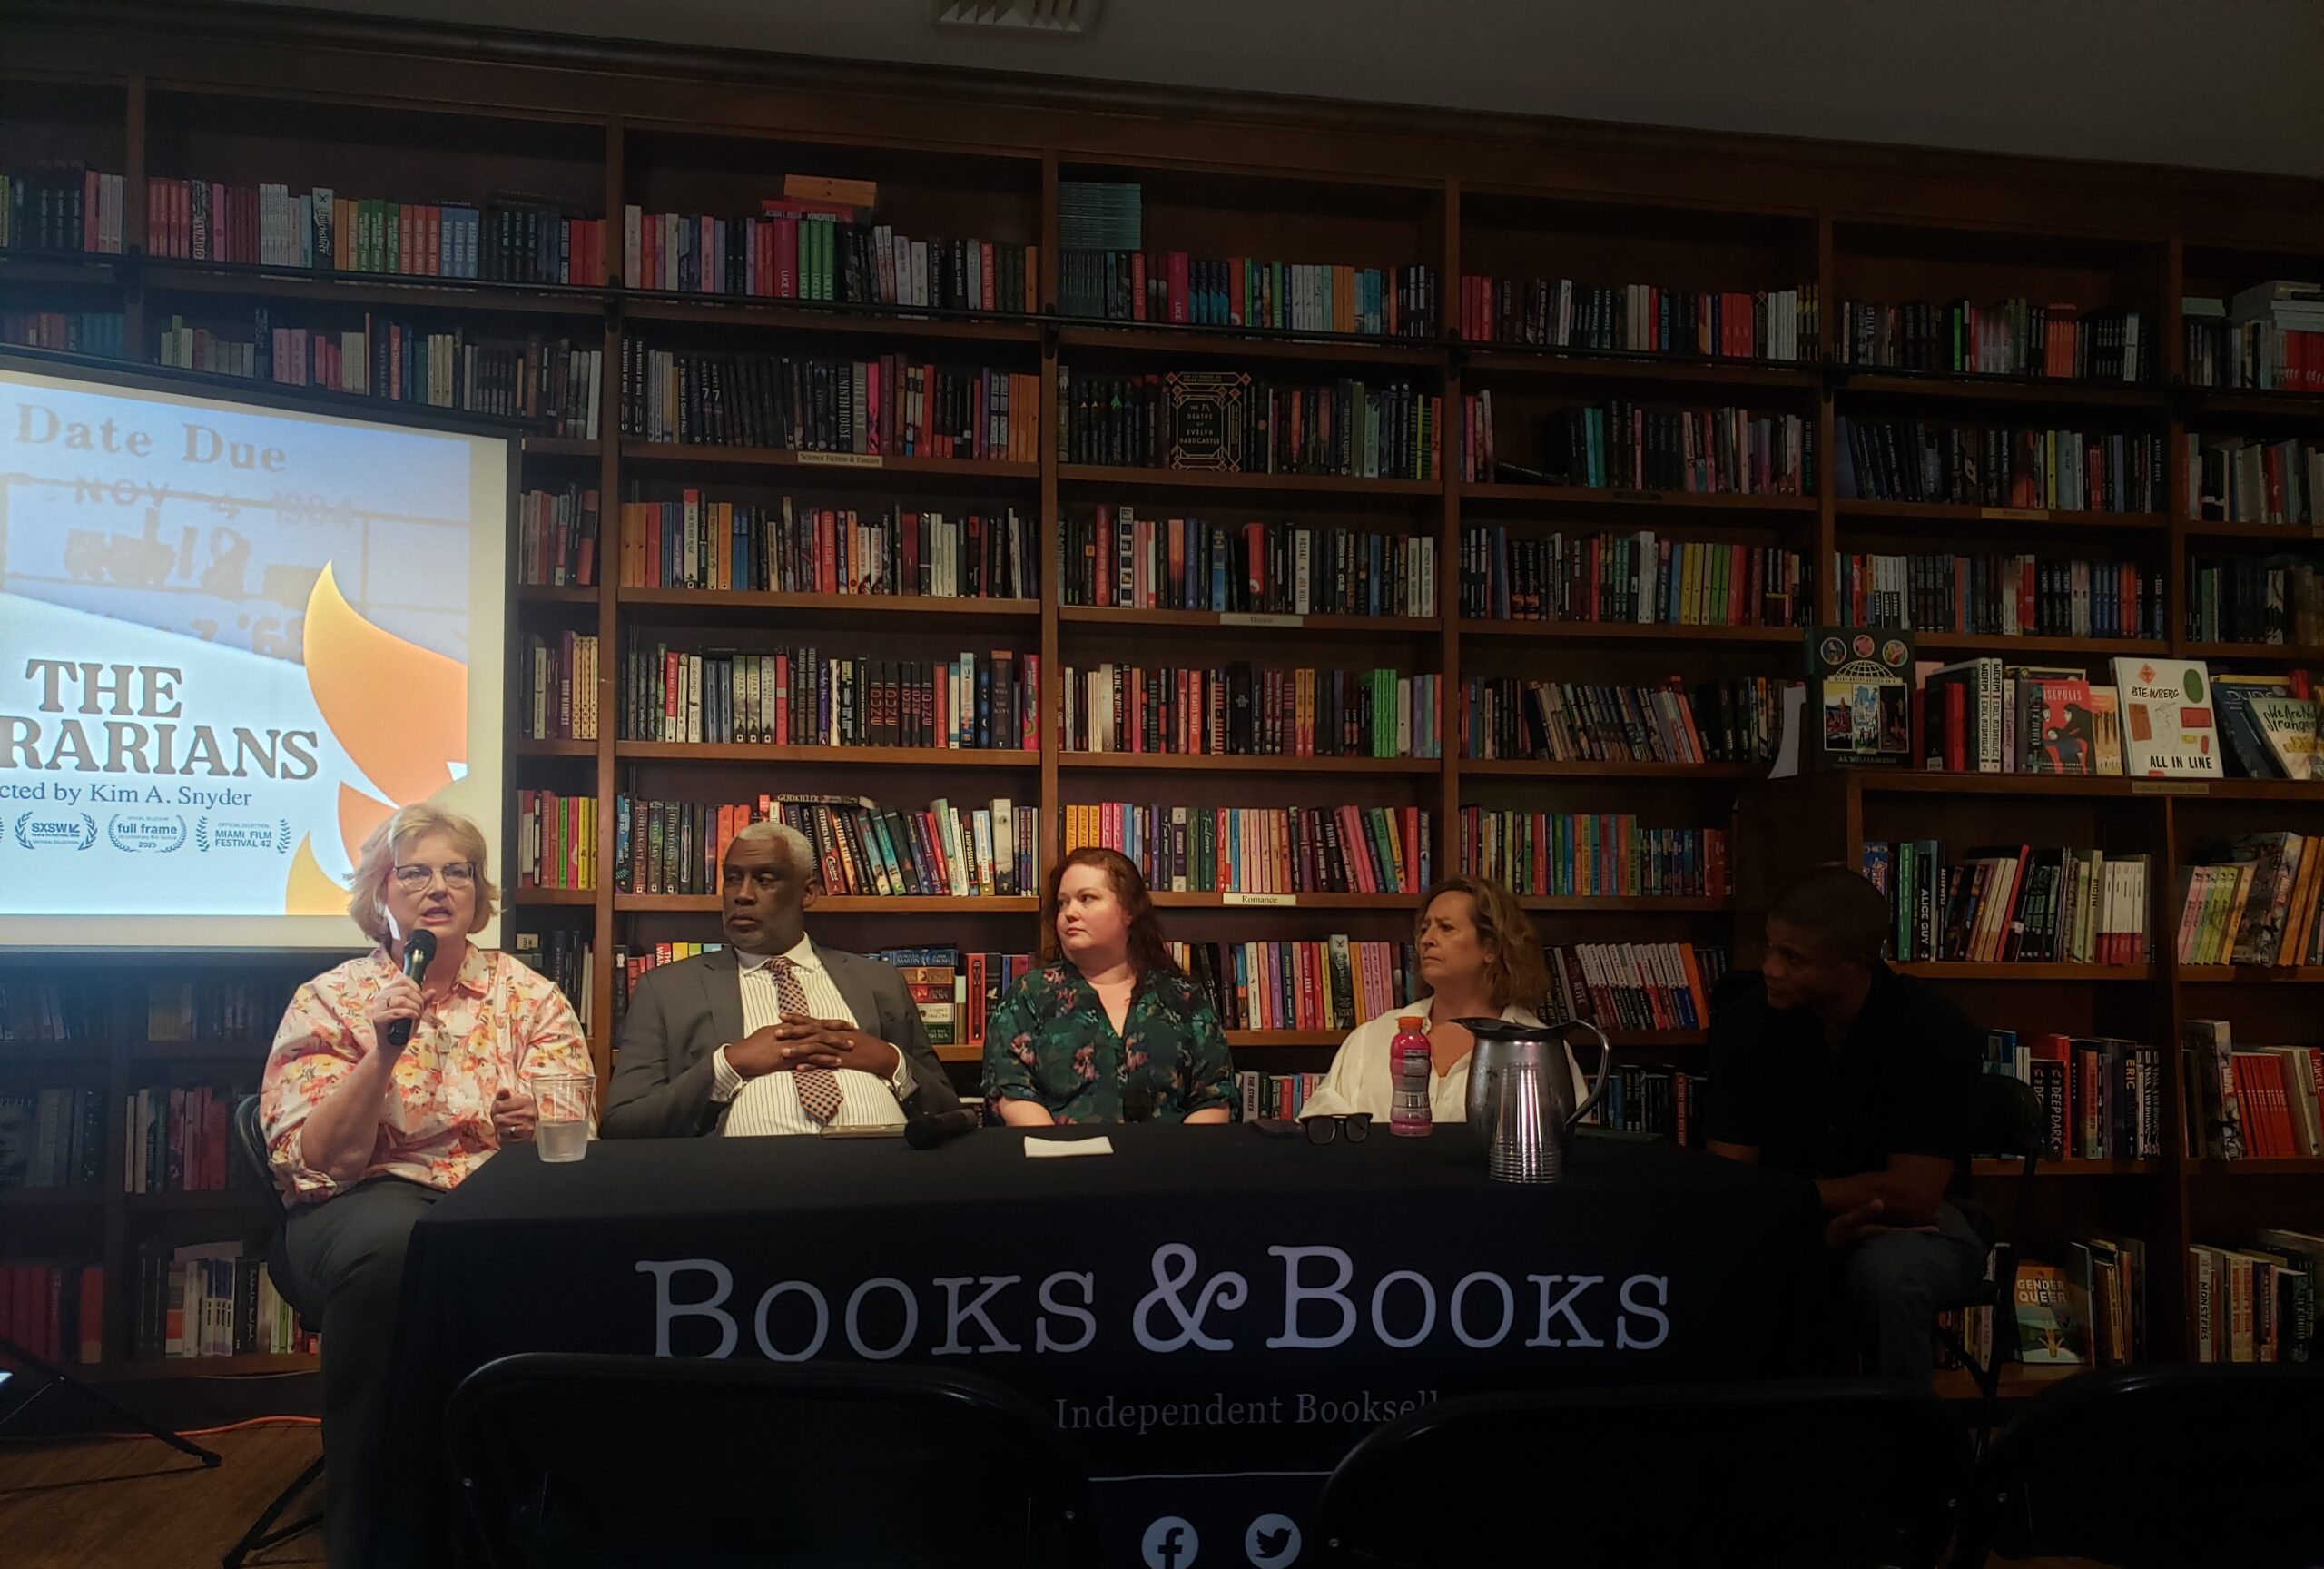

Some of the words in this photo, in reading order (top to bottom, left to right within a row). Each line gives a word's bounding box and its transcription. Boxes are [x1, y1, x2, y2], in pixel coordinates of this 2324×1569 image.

[194, 221, 204, 257] SUMUD
[781, 290, 789, 298] U
[838, 380, 851, 408] NINTH
[14, 403, 153, 458] Date
[182, 423, 286, 473] Due
[838, 410, 851, 439] HOUSE
[25, 658, 184, 719] THE
[1114, 669, 1122, 690] LONE
[2131, 686, 2180, 699] STEINBERG
[1114, 693, 1122, 723] WOMEN
[2043, 689, 2083, 701] SEPOLIS
[2268, 704, 2283, 719] We
[2285, 704, 2301, 720] Are
[0, 715, 320, 781] RARIANS
[2150, 755, 2168, 768] ALL
[2172, 755, 2183, 768] IN
[2189, 756, 2213, 769] LINE
[0, 783, 46, 800] cted
[54, 783, 82, 805] by
[90, 784, 139, 804] Kim
[145, 786, 171, 804] A.
[178, 786, 253, 809] Snyder
[117, 822, 138, 834] full
[141, 823, 177, 834] frame
[215, 829, 246, 839] MIAMI
[250, 830, 271, 840] FILM
[818, 808, 829, 836] STEPHEN
[215, 838, 258, 849] FESTIVAL
[260, 840, 271, 849] 42
[822, 837, 832, 853] KING
[965, 835, 975, 872] DISPOSSESSED
[1242, 895, 1278, 903] Romance
[1921, 888, 1929, 919] ALICE
[1921, 922, 1929, 945] GUY
[2126, 1059, 2135, 1090] ERIC
[2221, 1067, 2234, 1095] MARVEL
[2051, 1086, 2062, 1113] DEEP
[2051, 1115, 2062, 1144] DARK
[1131, 1240, 1247, 1353] &
[2017, 1279, 2065, 1290] GENDER
[2018, 1291, 2067, 1304] QUEER
[2200, 1281, 2208, 1341] MONSTERS
[1056, 1393, 1283, 1436] Independent
[1296, 1390, 1439, 1426] Booksell
